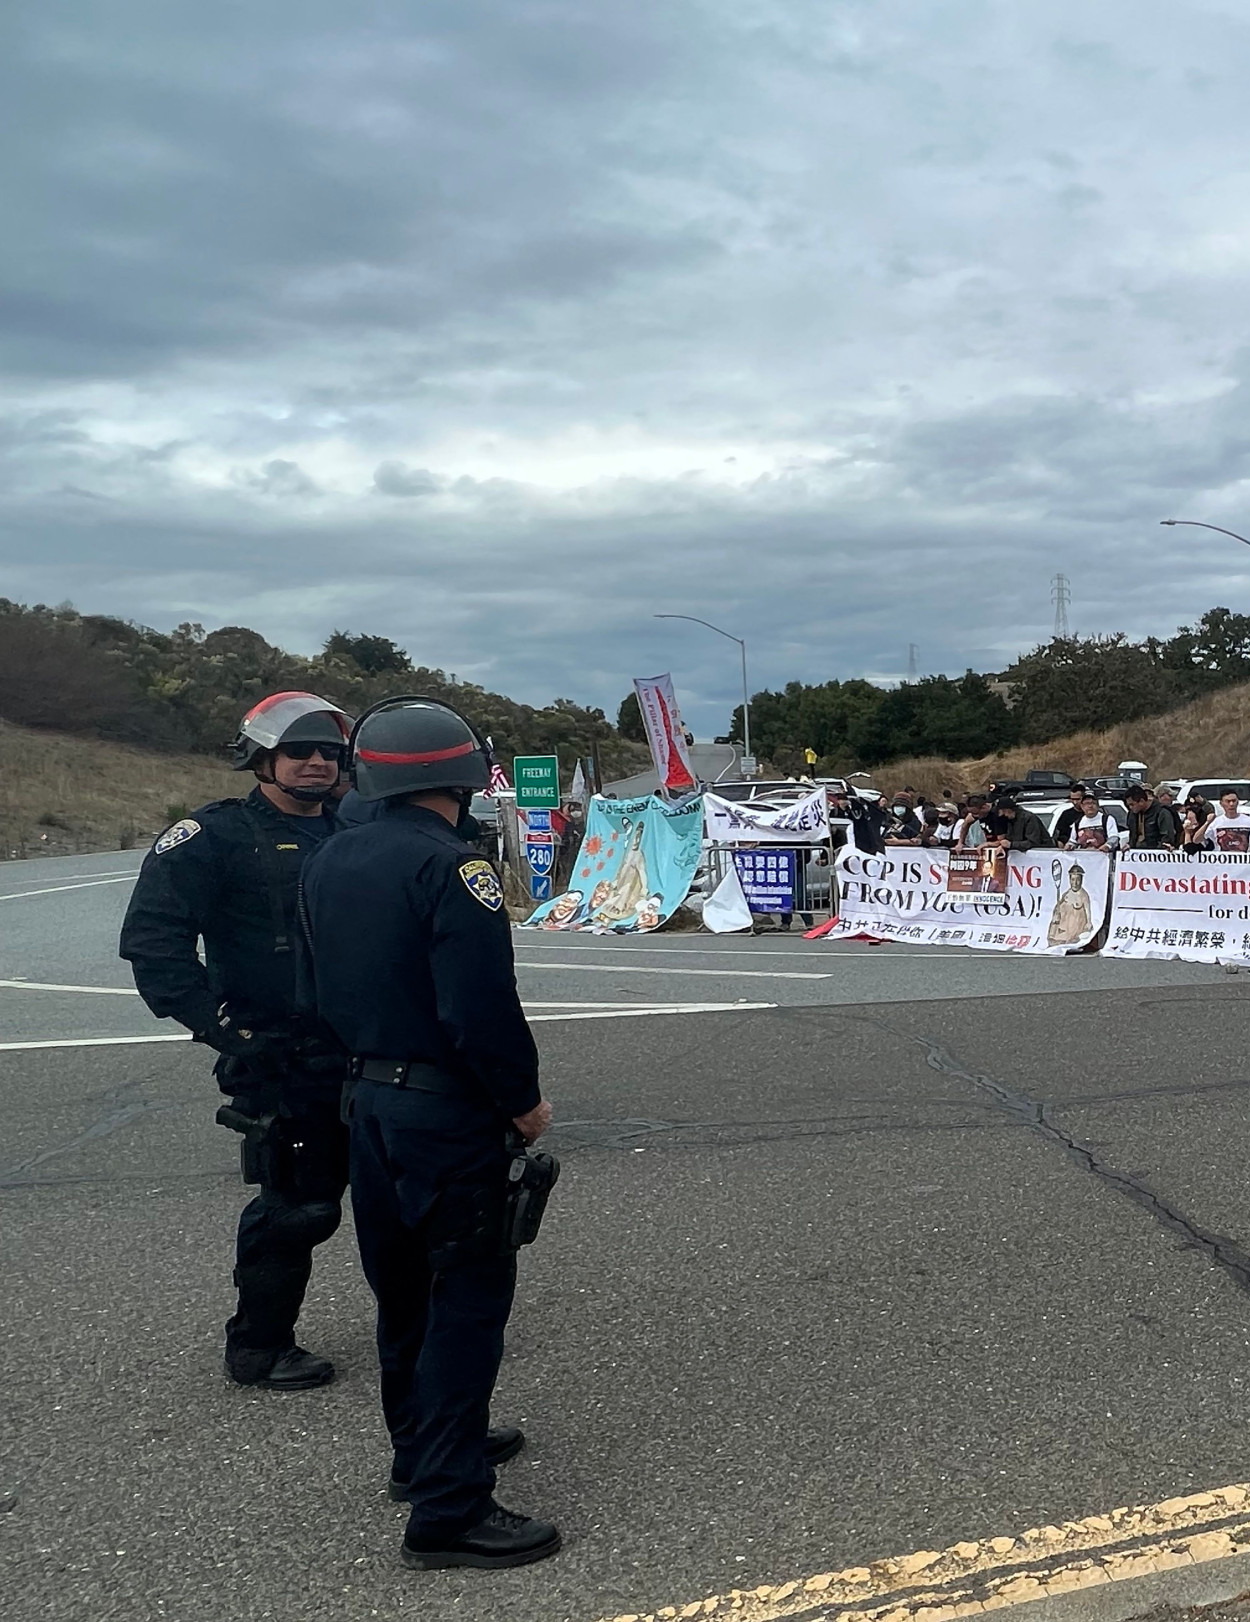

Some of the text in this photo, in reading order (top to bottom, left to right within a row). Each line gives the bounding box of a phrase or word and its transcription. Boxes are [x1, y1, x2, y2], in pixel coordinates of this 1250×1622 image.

[648, 704, 659, 727] Pillar
[522, 768, 551, 778] FREEWAY
[521, 787, 555, 797] ENTRANCE
[530, 848, 550, 866] 280
[1120, 852, 1193, 865] Economic
[842, 855, 895, 881] CCP
[901, 862, 922, 884] IS
[841, 880, 914, 911] FROM
[1208, 905, 1234, 919] for
